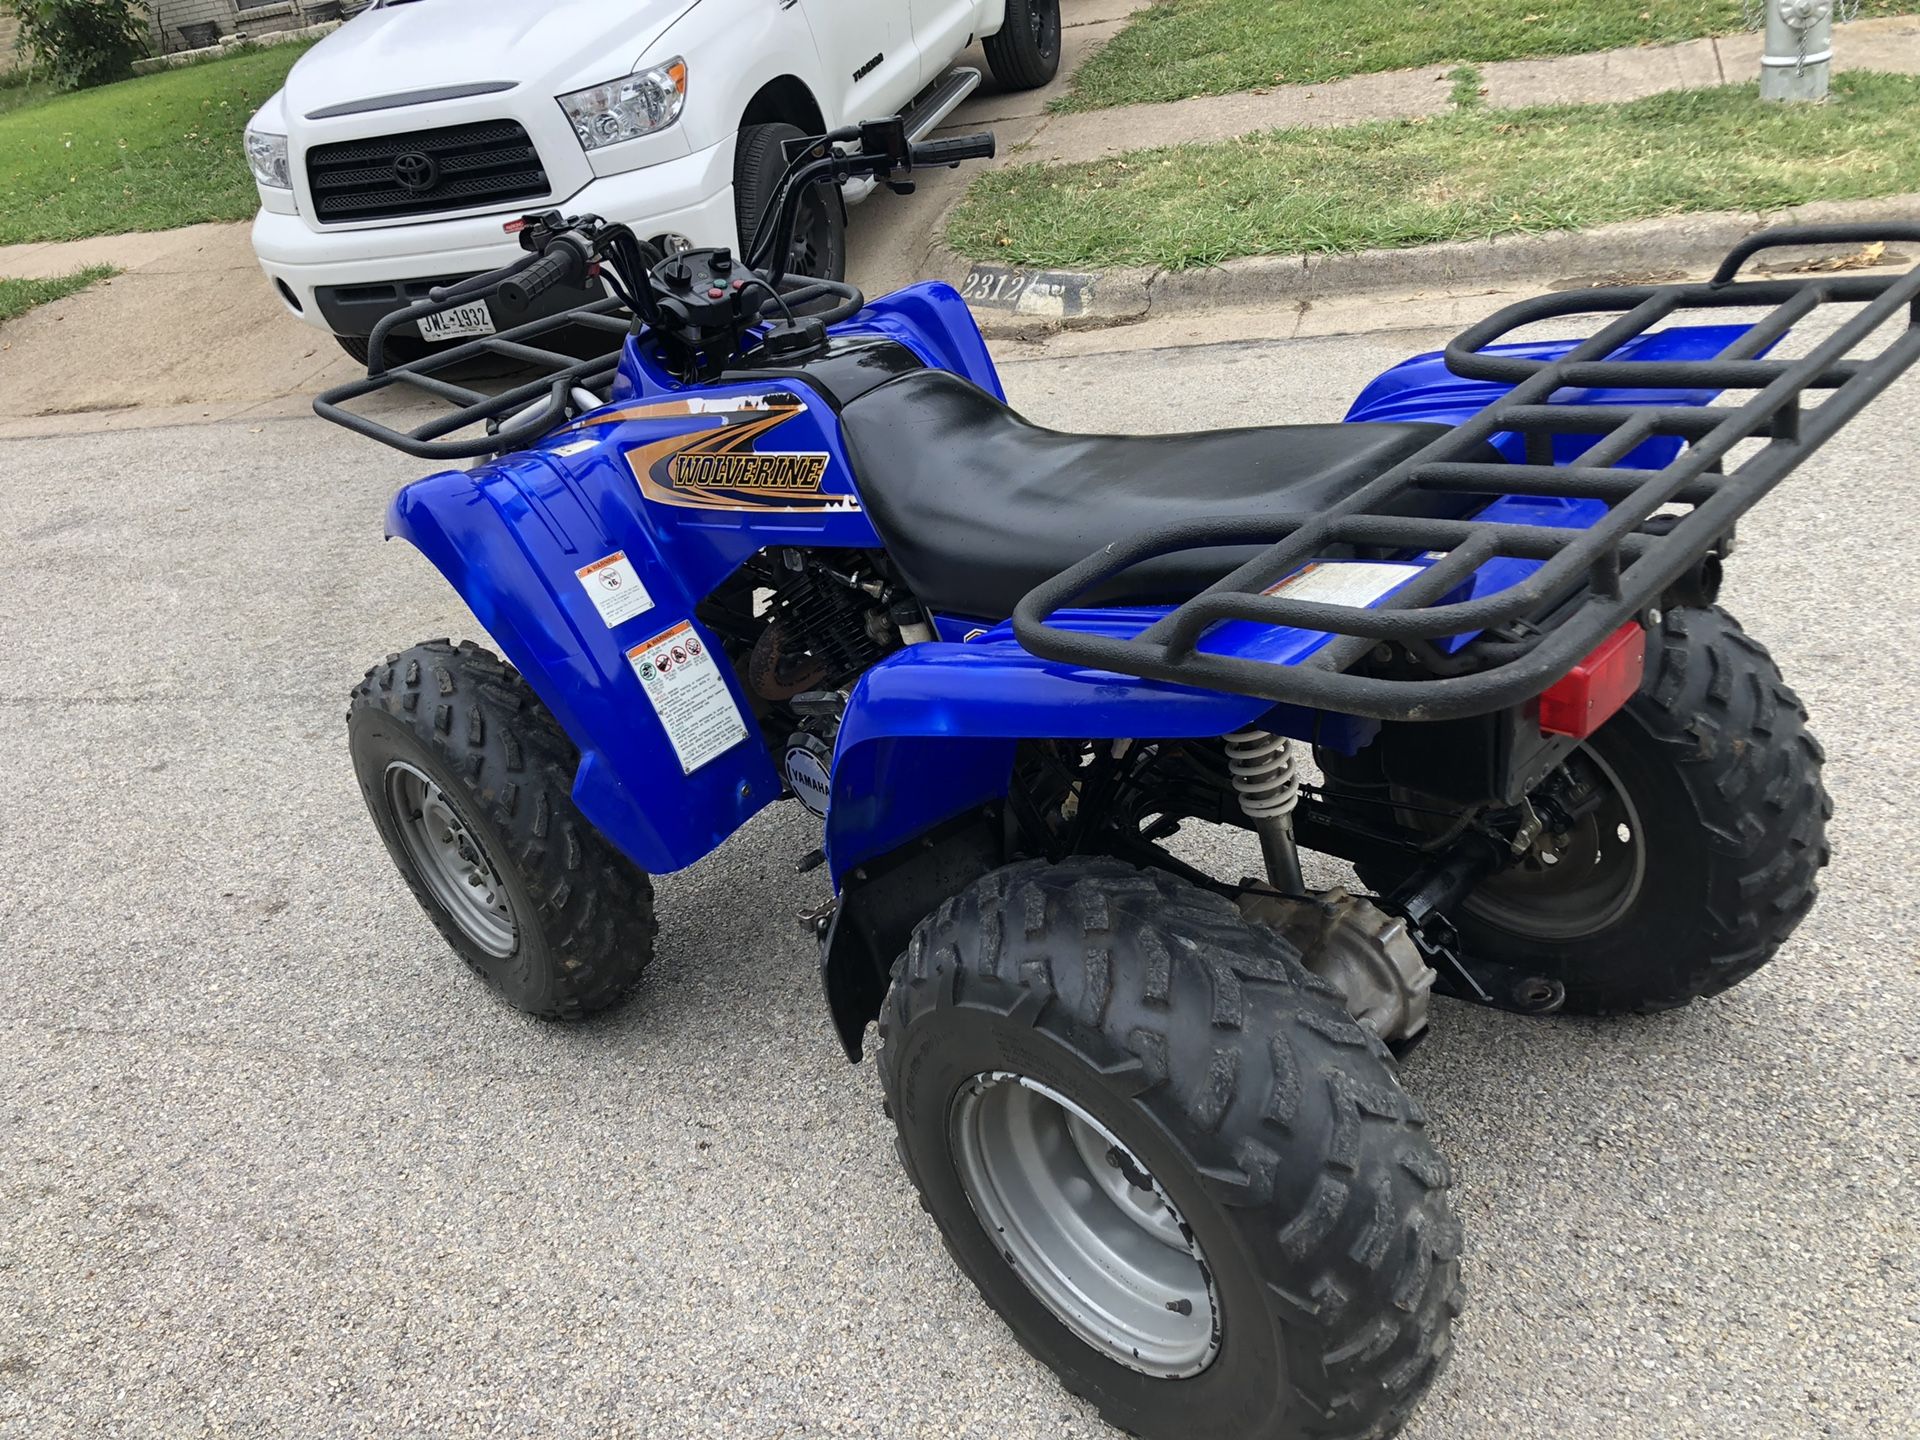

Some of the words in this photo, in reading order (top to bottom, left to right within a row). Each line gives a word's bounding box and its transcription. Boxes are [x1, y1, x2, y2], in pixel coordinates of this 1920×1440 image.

[962, 272, 1025, 301] 2312
[453, 307, 489, 328] 1932
[675, 454, 827, 489] WOLVERINE
[607, 578, 618, 587] 16
[791, 768, 830, 796] YAMAHA
